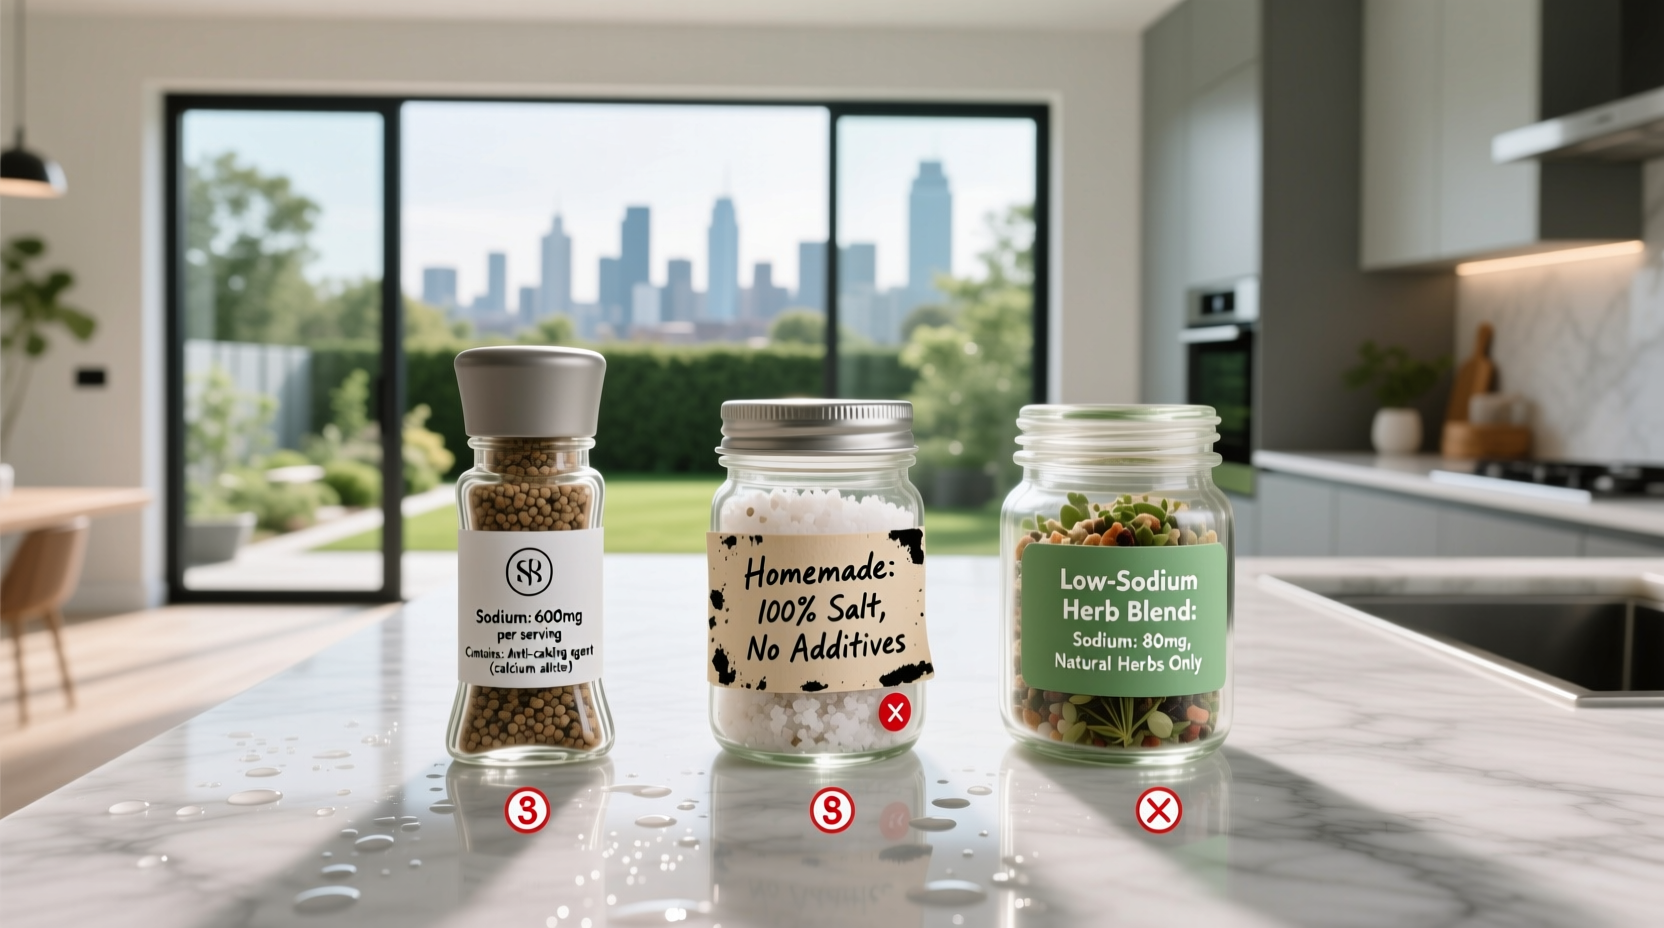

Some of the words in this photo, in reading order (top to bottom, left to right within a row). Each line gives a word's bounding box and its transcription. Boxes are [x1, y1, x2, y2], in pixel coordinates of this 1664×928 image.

[745, 551, 895, 590] Homemade:
[1060, 568, 1198, 591] Low-Sodium
[476, 609, 531, 624] Sodium:
[535, 609, 582, 625] 600mg
[758, 595, 816, 626] 100%
[827, 592, 886, 623] Salt,
[1063, 599, 1119, 622] Herb
[1128, 599, 1197, 622] Blend:
[498, 631, 516, 644] per
[521, 627, 561, 642] serving
[747, 634, 779, 661] No
[790, 630, 906, 662] Additives
[1073, 632, 1137, 649] Sodium:
[1143, 633, 1191, 651] 80mg,
[490, 662, 535, 675] (calcium
[1055, 653, 1111, 671] Natural
[1118, 655, 1164, 672] Herbs
[1169, 654, 1202, 675] Only
